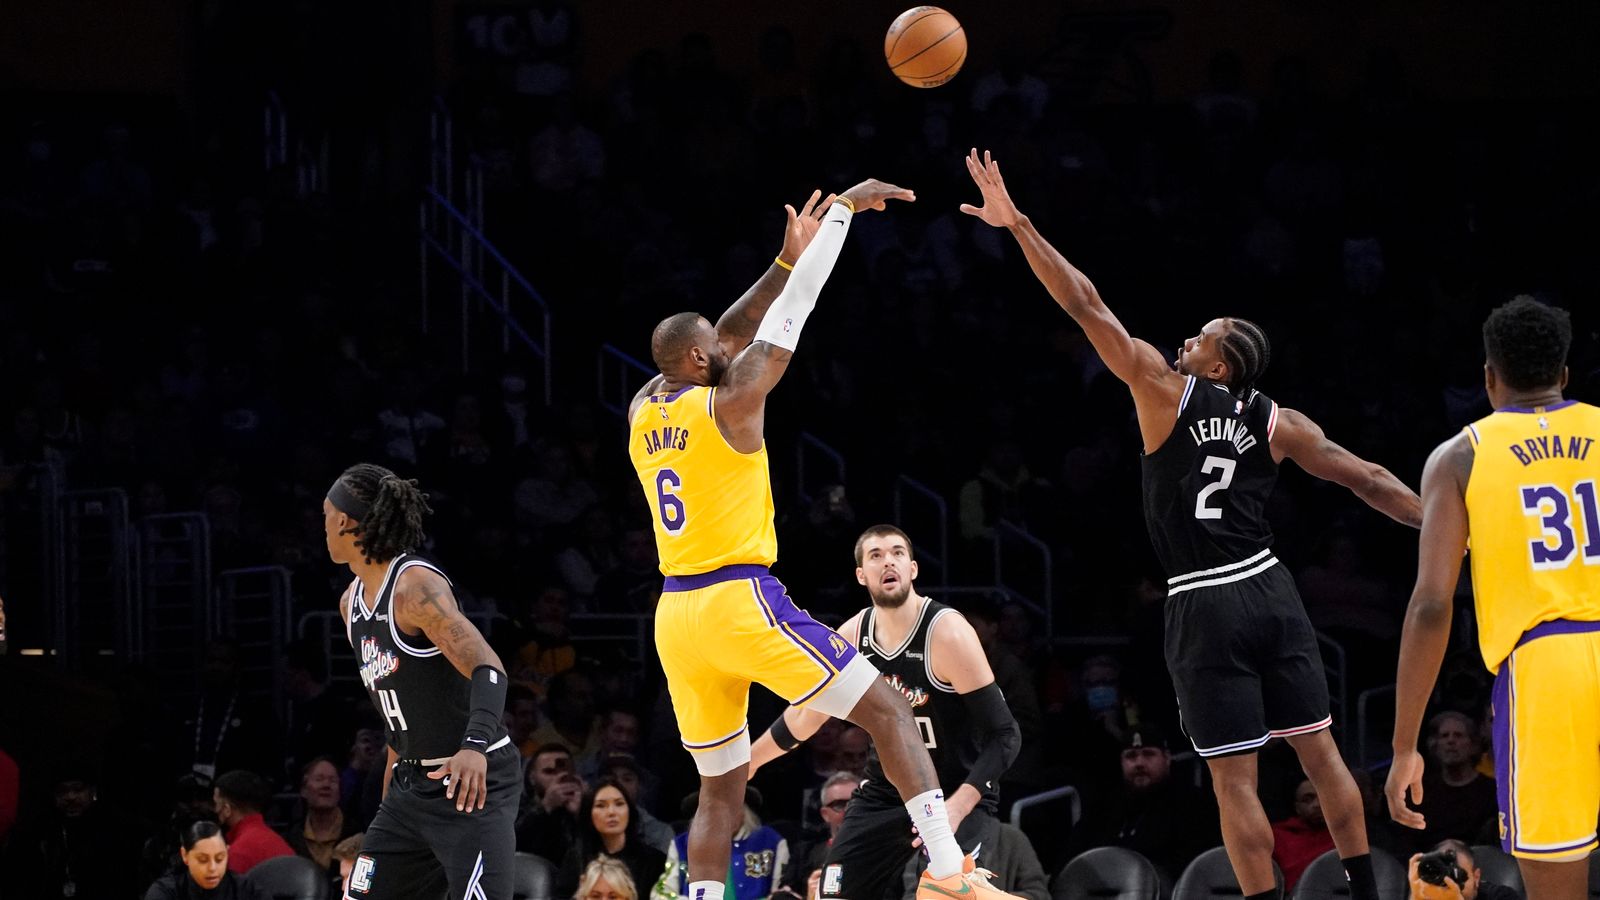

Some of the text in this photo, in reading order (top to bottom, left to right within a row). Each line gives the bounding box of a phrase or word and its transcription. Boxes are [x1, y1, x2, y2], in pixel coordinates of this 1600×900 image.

[644, 427, 689, 455] JAMES
[1509, 435, 1595, 467] BRYANT
[655, 467, 687, 537] 6
[1195, 455, 1237, 519] 2
[1519, 479, 1600, 572] 31
[378, 689, 408, 732] 14
